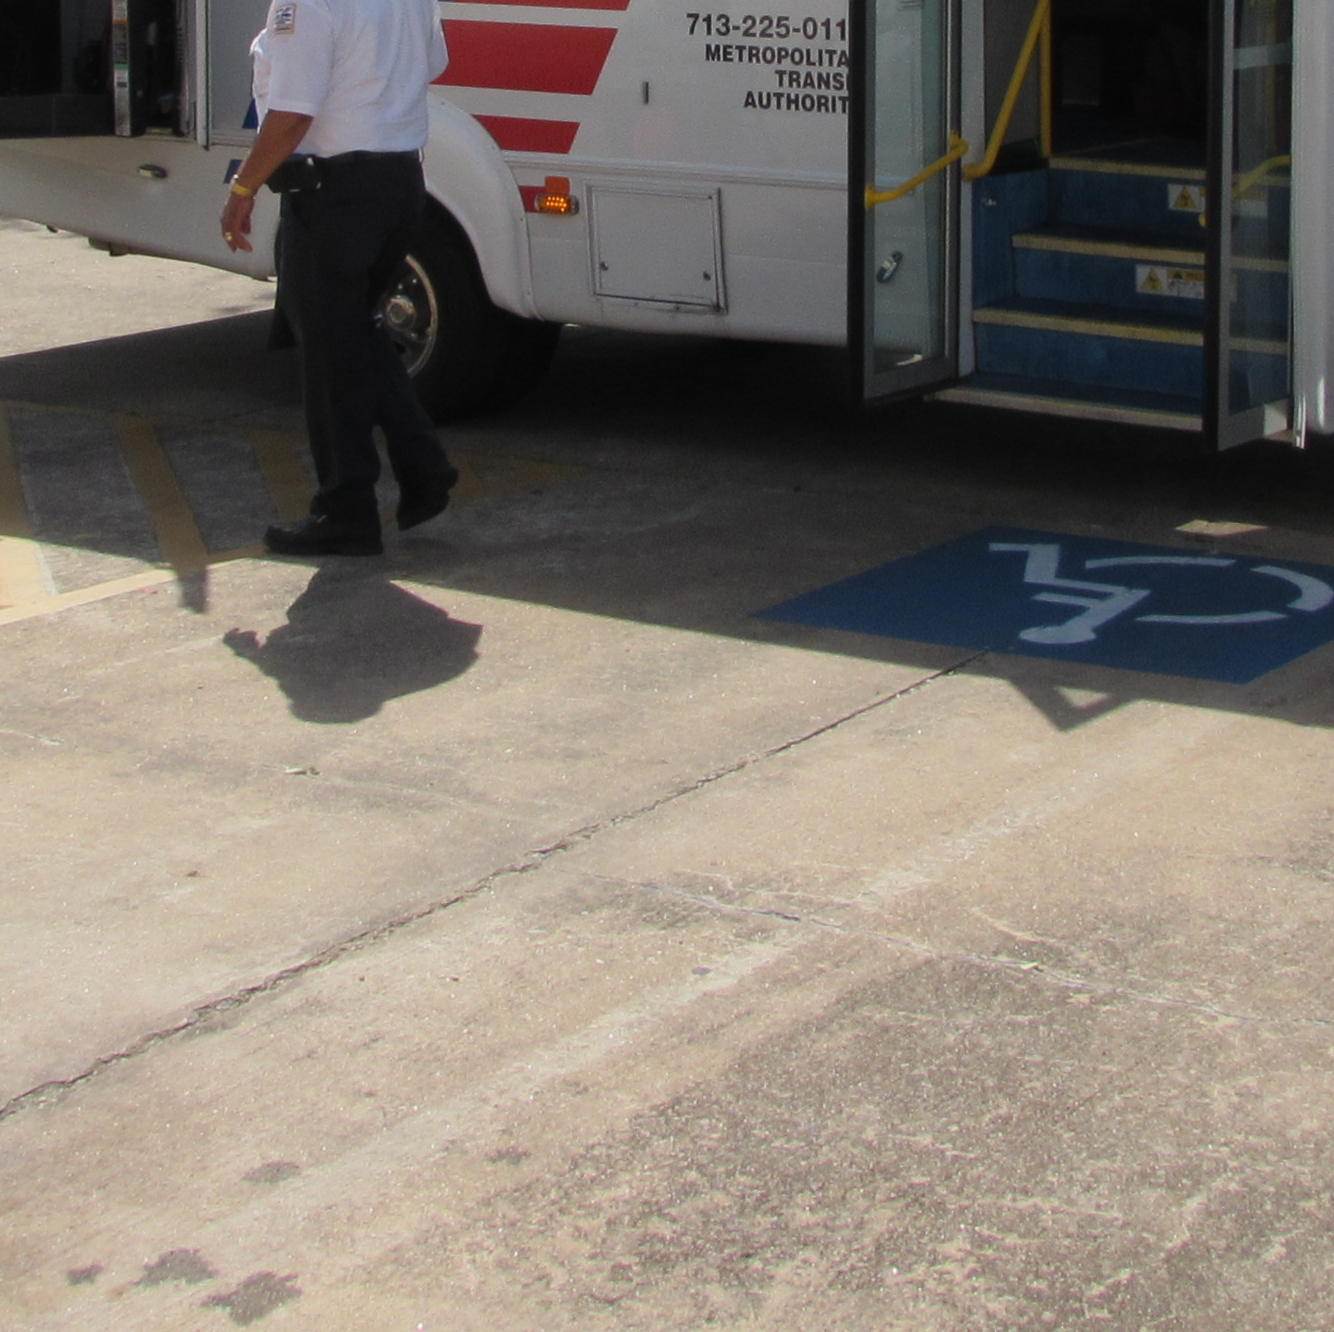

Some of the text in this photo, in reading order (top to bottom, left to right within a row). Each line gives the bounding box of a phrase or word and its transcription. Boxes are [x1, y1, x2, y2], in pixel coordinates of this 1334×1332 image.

[686, 12, 846, 41] 713-225-011
[705, 43, 850, 68] METROPOLITA
[775, 69, 850, 92] TRANS
[744, 90, 850, 115] AUTHORIT
